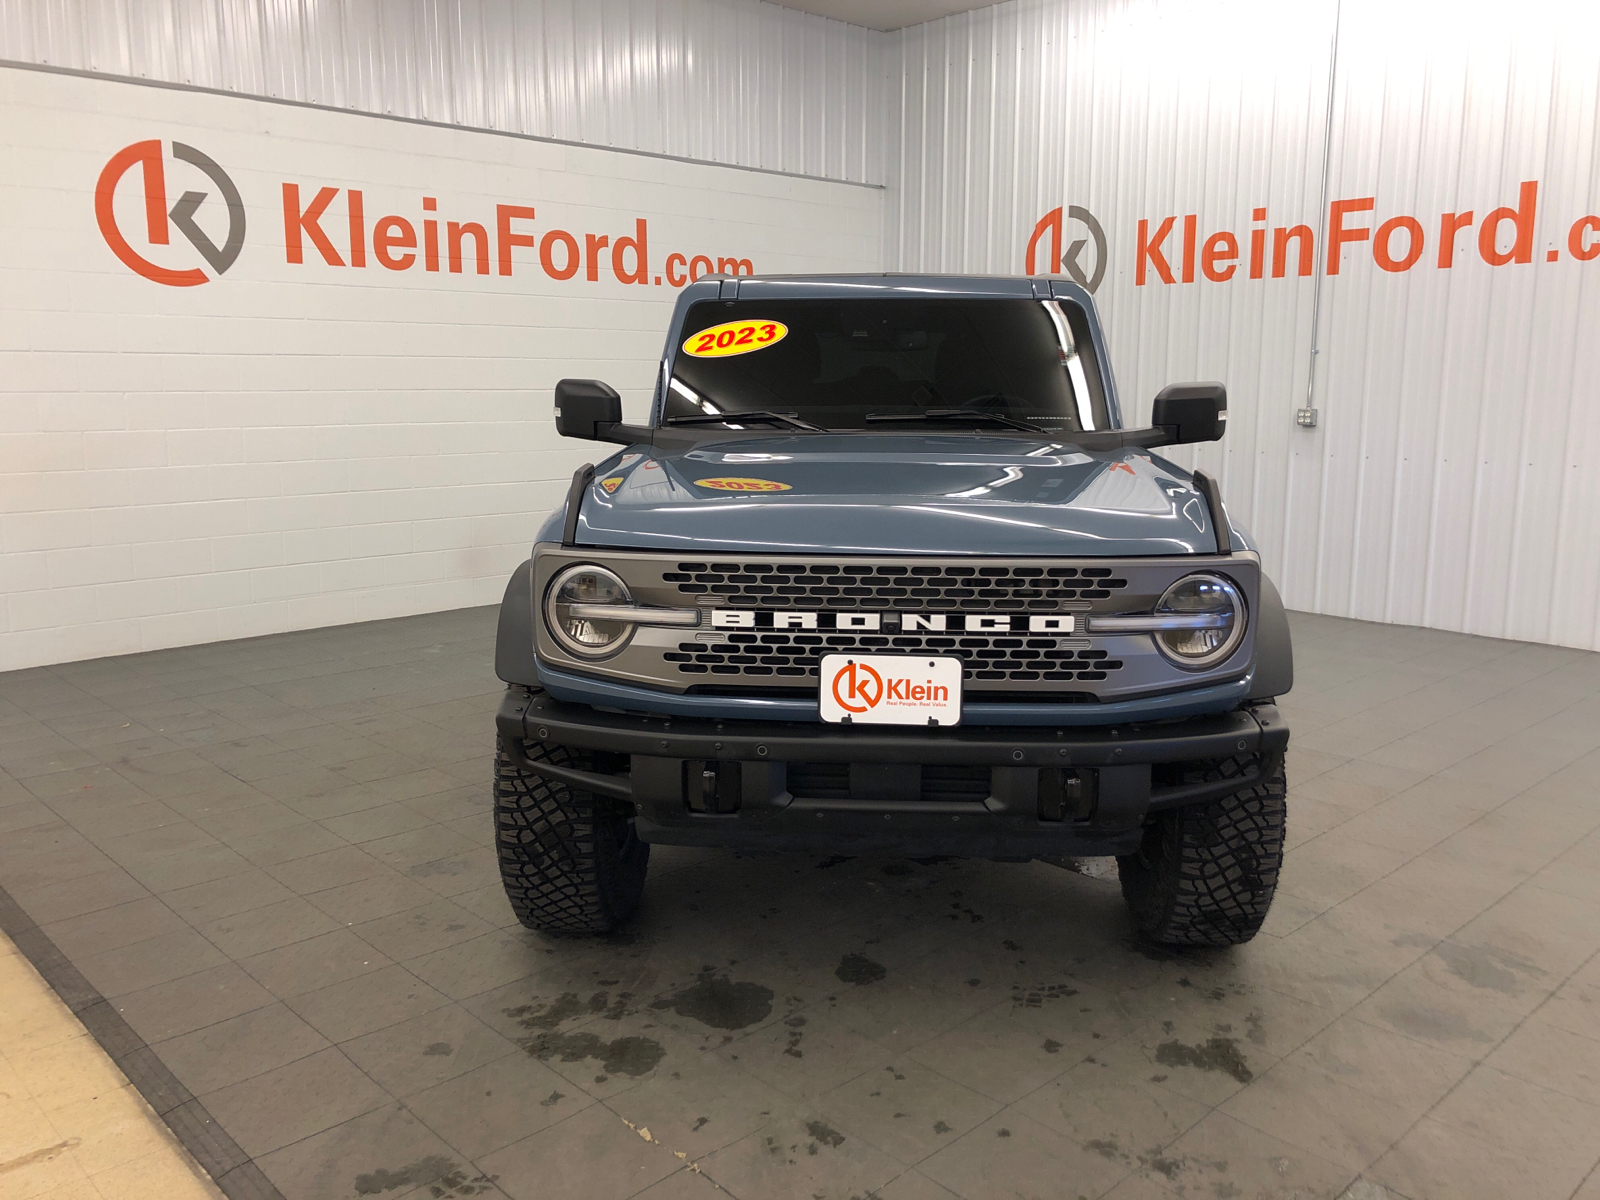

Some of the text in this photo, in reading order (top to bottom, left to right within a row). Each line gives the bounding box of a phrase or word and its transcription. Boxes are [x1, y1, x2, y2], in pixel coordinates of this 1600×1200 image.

[282, 182, 754, 288] KleinFord.com
[695, 324, 777, 353] 2023
[711, 609, 1075, 633] BRONCO
[887, 678, 949, 701] Klein
